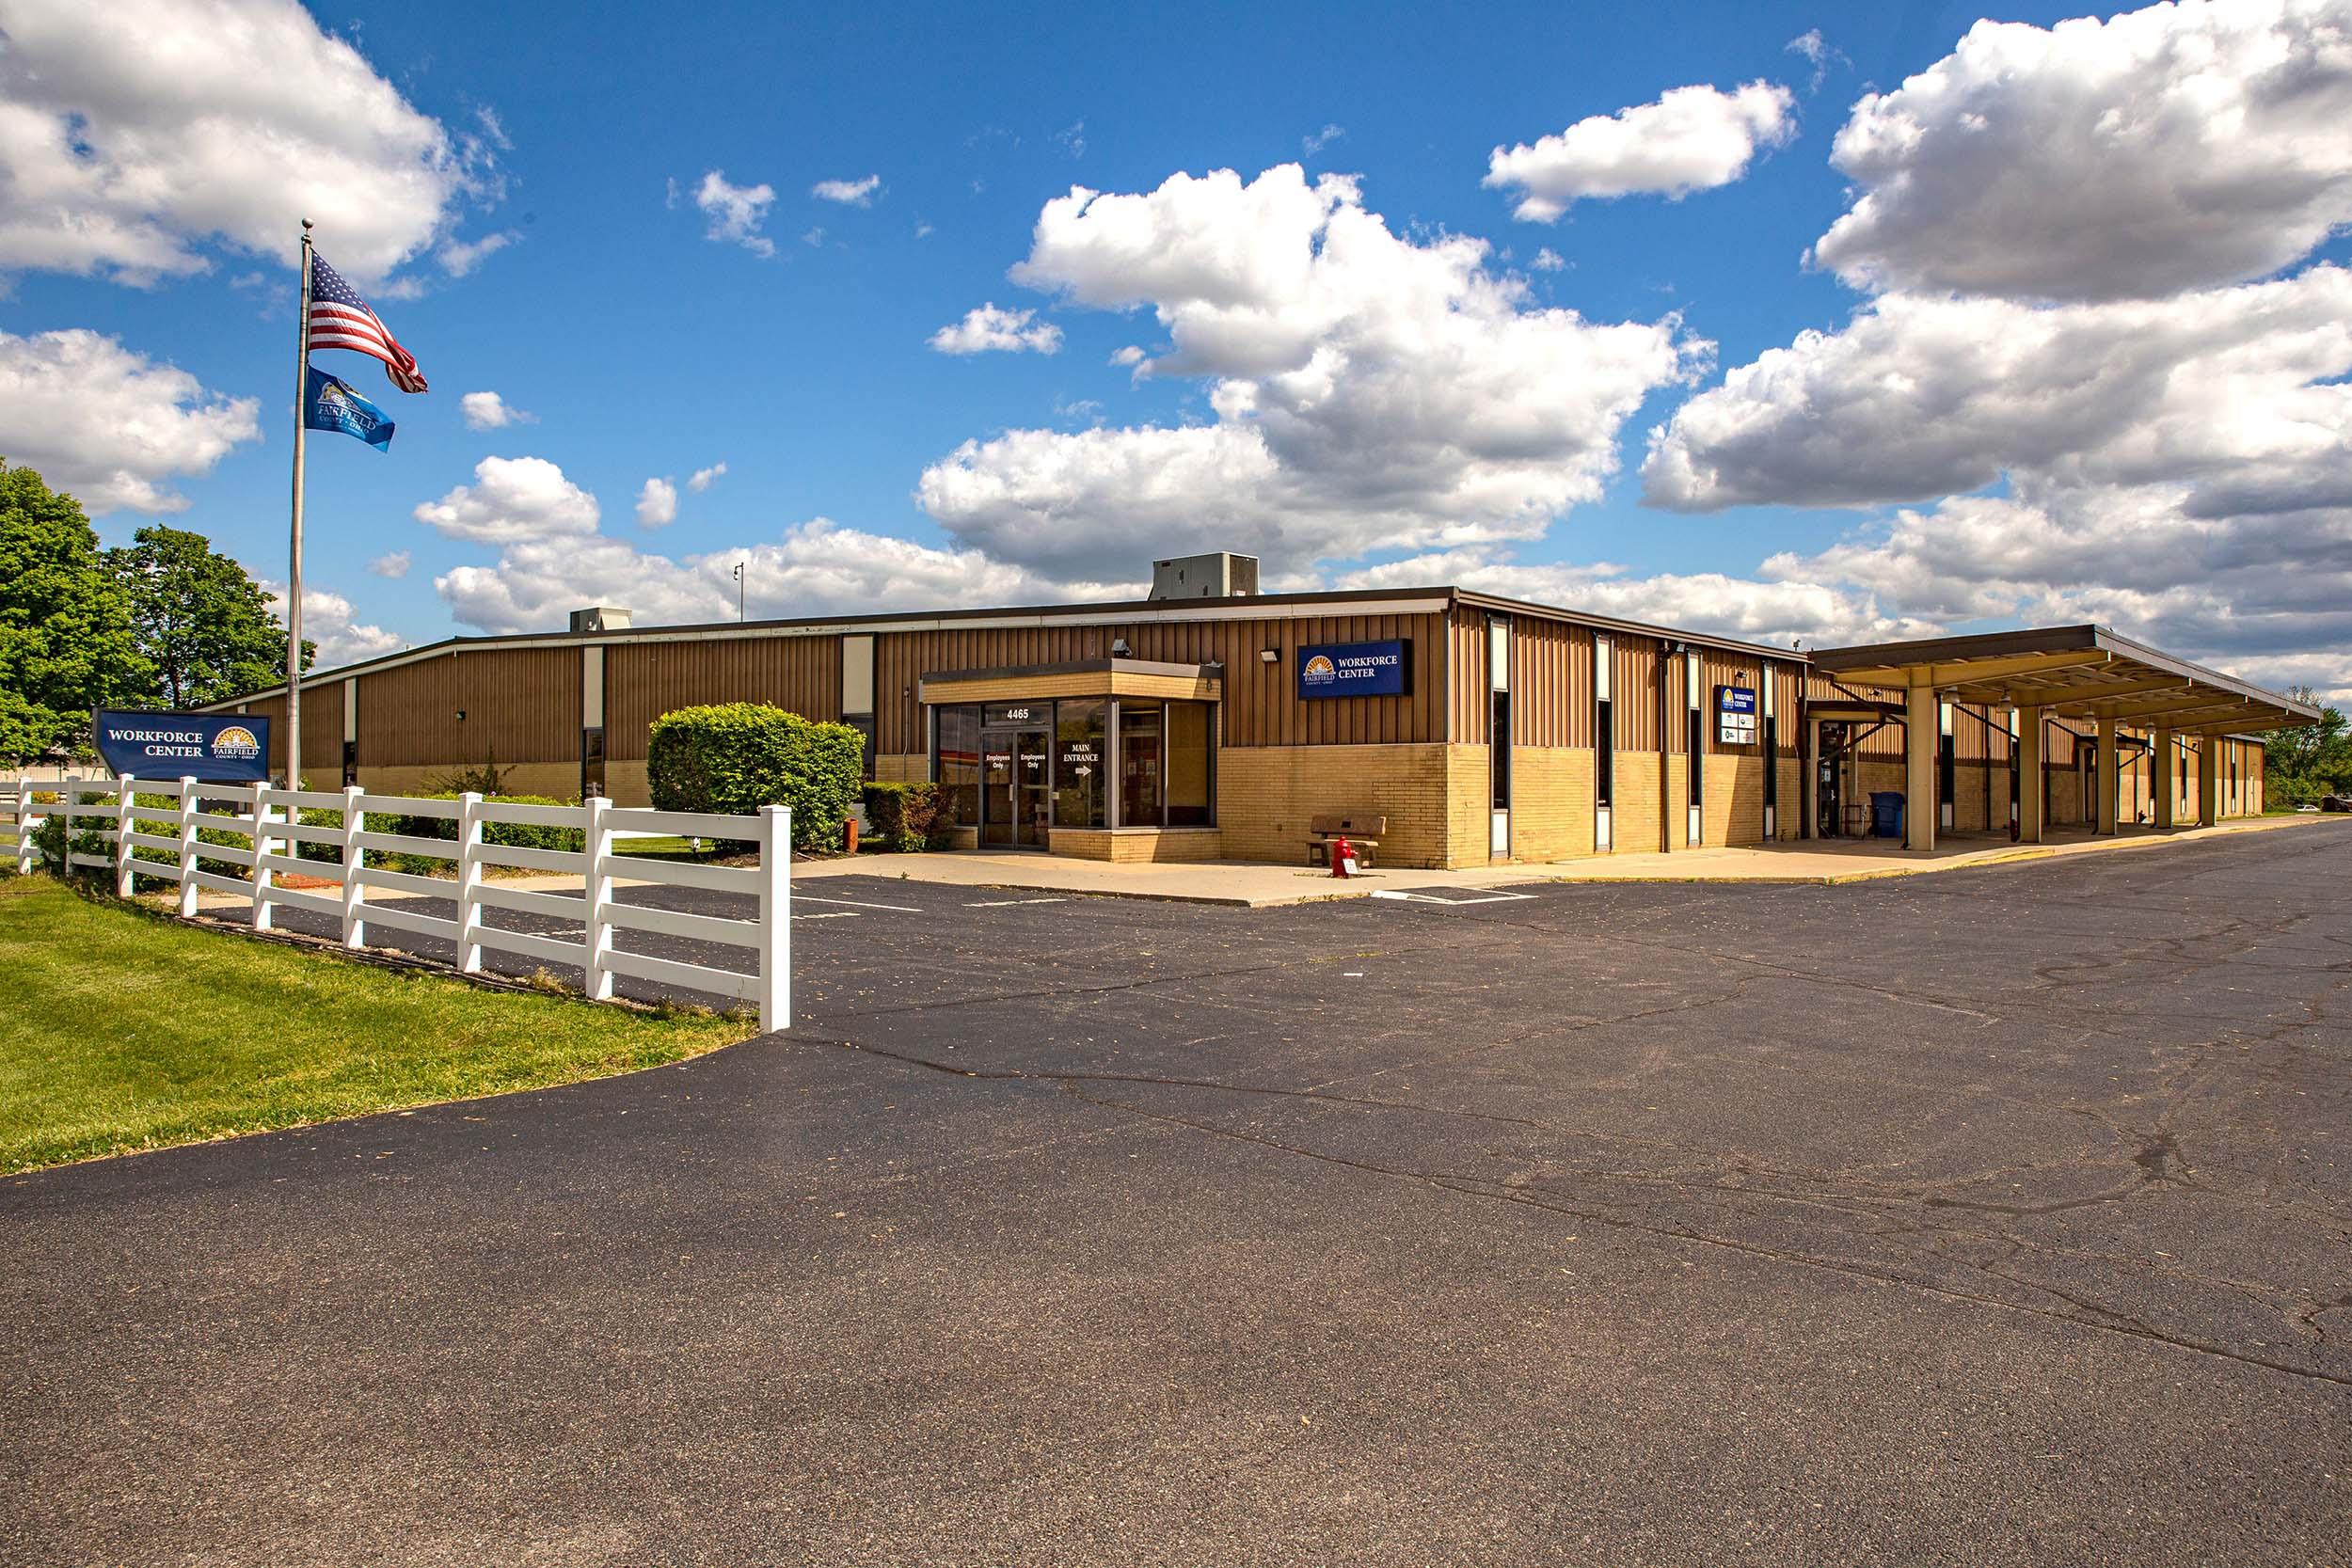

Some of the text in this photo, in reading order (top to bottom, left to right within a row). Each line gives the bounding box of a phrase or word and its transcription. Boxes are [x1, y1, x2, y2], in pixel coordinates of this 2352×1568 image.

[318, 404, 376, 430] FAIRFIELD
[1339, 656, 1397, 667] WORKFORCE
[1338, 669, 1375, 678] CENTER
[1007, 708, 1029, 720] 4465
[108, 729, 203, 743] WORKFORCE
[146, 745, 203, 757] CENTER
[1063, 753, 1099, 762] ENTRANCE
